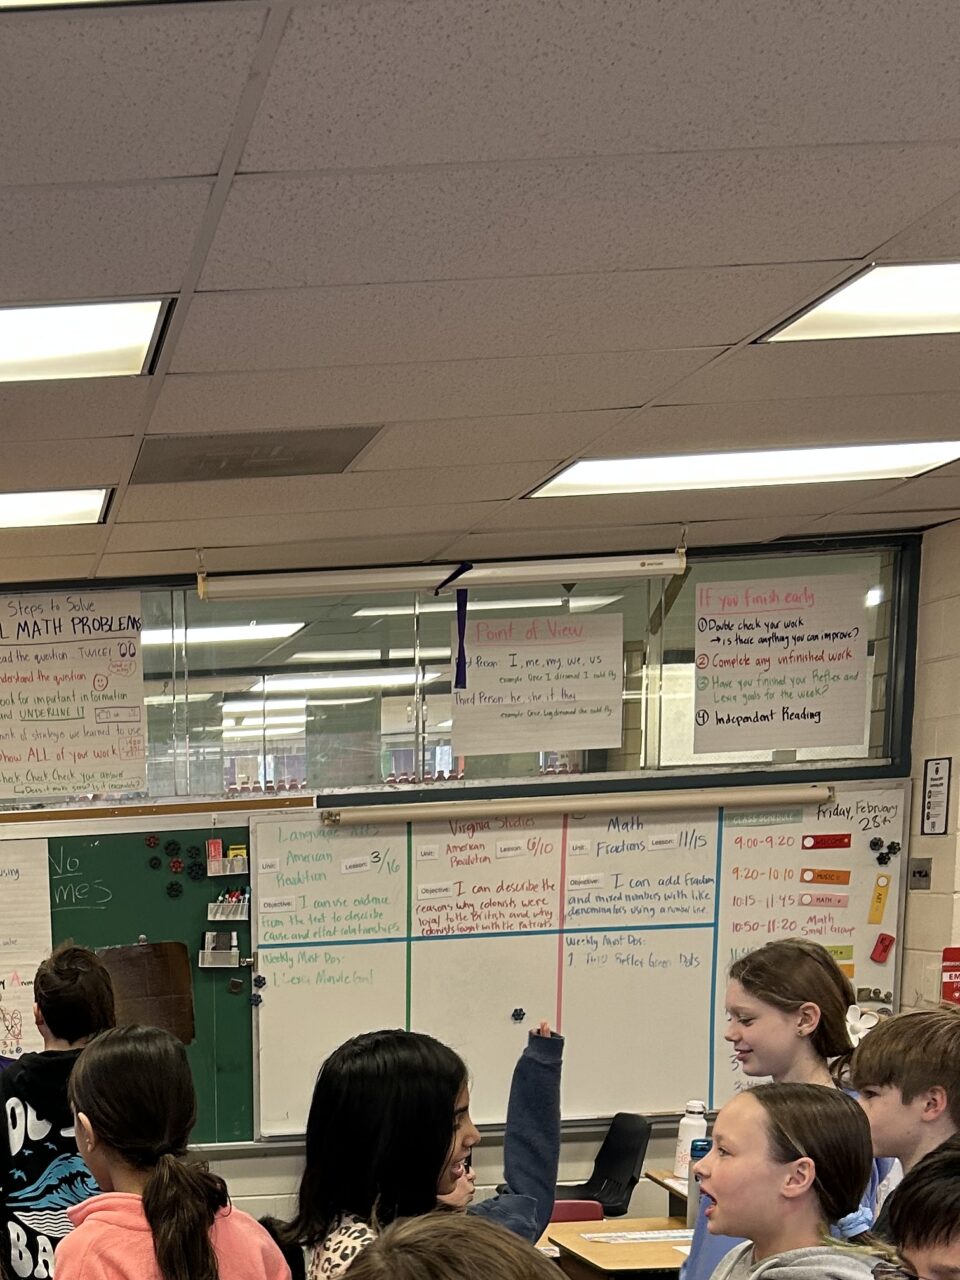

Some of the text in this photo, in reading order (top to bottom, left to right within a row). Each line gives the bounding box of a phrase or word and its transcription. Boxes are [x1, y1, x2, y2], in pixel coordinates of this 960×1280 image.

[700, 586, 815, 610] If you finish early
[8, 596, 95, 618] Steps to Solve
[17, 617, 62, 641] MATH
[71, 615, 142, 635] PROBLEMS
[476, 619, 584, 641] Point of View
[708, 617, 804, 633] Double check your work
[735, 633, 755, 645] there
[757, 632, 789, 649] anything
[792, 634, 805, 645] you
[807, 633, 819, 642] can
[820, 627, 859, 642] improve?
[16, 650, 30, 662] the
[35, 649, 67, 664] question
[712, 648, 852, 671] Complete any unfinished work
[38, 670, 50, 681] the
[53, 669, 86, 685] question
[712, 675, 733, 689] Have
[738, 680, 752, 691] you
[757, 673, 785, 687] finished
[790, 677, 806, 688] your
[843, 671, 859, 681] and
[18, 690, 29, 705] for
[34, 691, 75, 706] important
[80, 689, 128, 703] information
[19, 706, 74, 719] UNDERLINE
[715, 706, 821, 725] Independent Reading
[20, 727, 28, 741] of
[69, 731, 80, 739] we
[83, 726, 110, 737] learned
[117, 725, 124, 735] to
[128, 727, 141, 736] use
[28, 747, 50, 762] ALL
[56, 747, 64, 761] of
[69, 752, 88, 764] your
[93, 745, 118, 759] work
[816, 800, 898, 820] Friday, February
[449, 815, 535, 839] Virginia Studies
[607, 815, 644, 833] Math
[278, 826, 339, 843] Language
[678, 829, 707, 850] 11/15
[286, 849, 333, 865] American
[446, 843, 485, 855] American
[596, 840, 646, 857] Fractions
[453, 879, 555, 896] I can describe the
[298, 895, 308, 910] I
[313, 899, 331, 909] can
[332, 899, 347, 907] use
[416, 898, 548, 914] reasons why colonists were
[568, 893, 591, 905] and
[595, 892, 622, 902] mixed
[625, 890, 660, 901] numbers
[664, 890, 687, 901] with
[261, 907, 383, 928] from the text to describe
[419, 914, 440, 927] loyal
[446, 913, 454, 923] to
[454, 912, 467, 922] the
[509, 911, 529, 919] and
[533, 908, 552, 920] why
[807, 912, 834, 925] Math
[801, 924, 827, 936] Small
